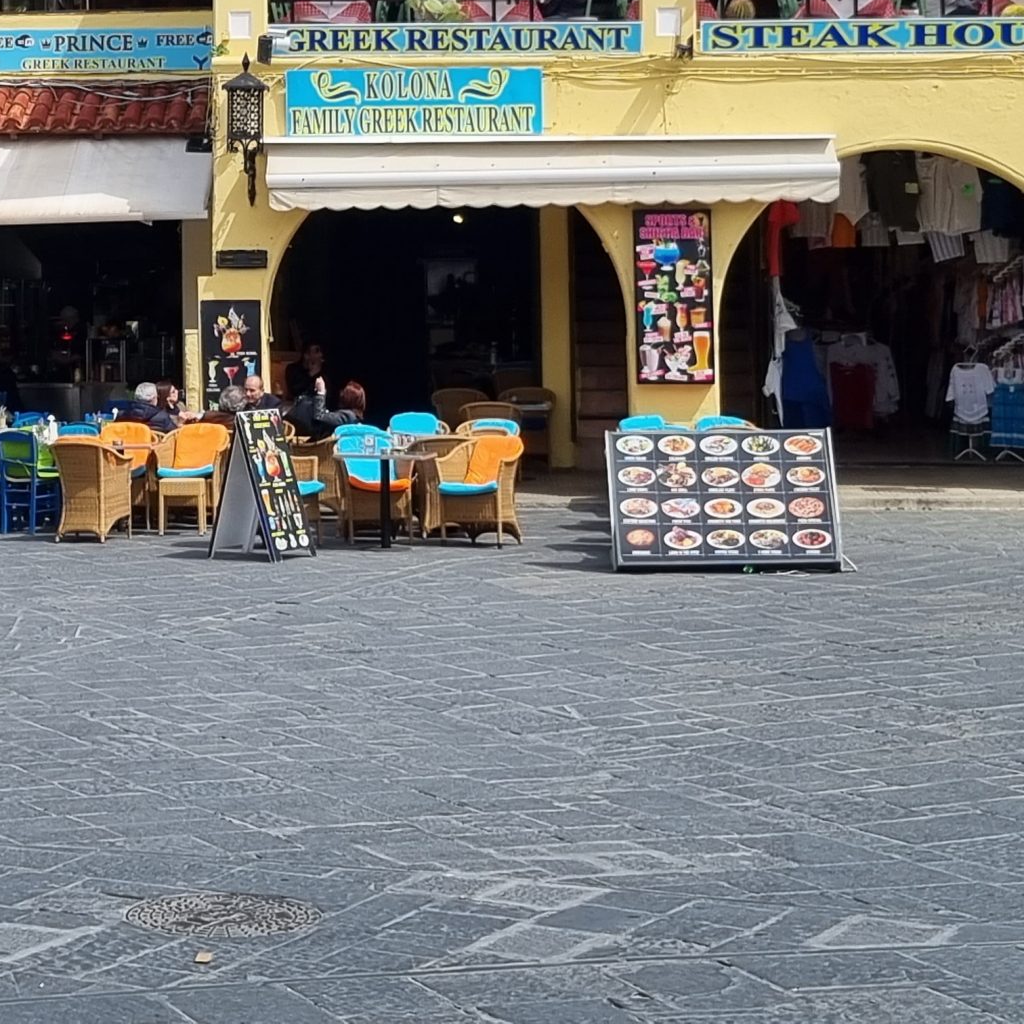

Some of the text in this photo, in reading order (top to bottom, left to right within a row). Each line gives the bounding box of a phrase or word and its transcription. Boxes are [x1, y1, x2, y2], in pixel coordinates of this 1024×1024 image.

[54, 35, 133, 52] PRINCE
[156, 34, 195, 47] FREE
[287, 27, 629, 53] GREEK RESTAURANT
[711, 23, 897, 49] STEAK
[22, 58, 166, 70] GREEK RESTAURANT
[365, 72, 453, 100] KOLONA
[291, 105, 535, 135] FAMILY GREEK RESTAURANT
